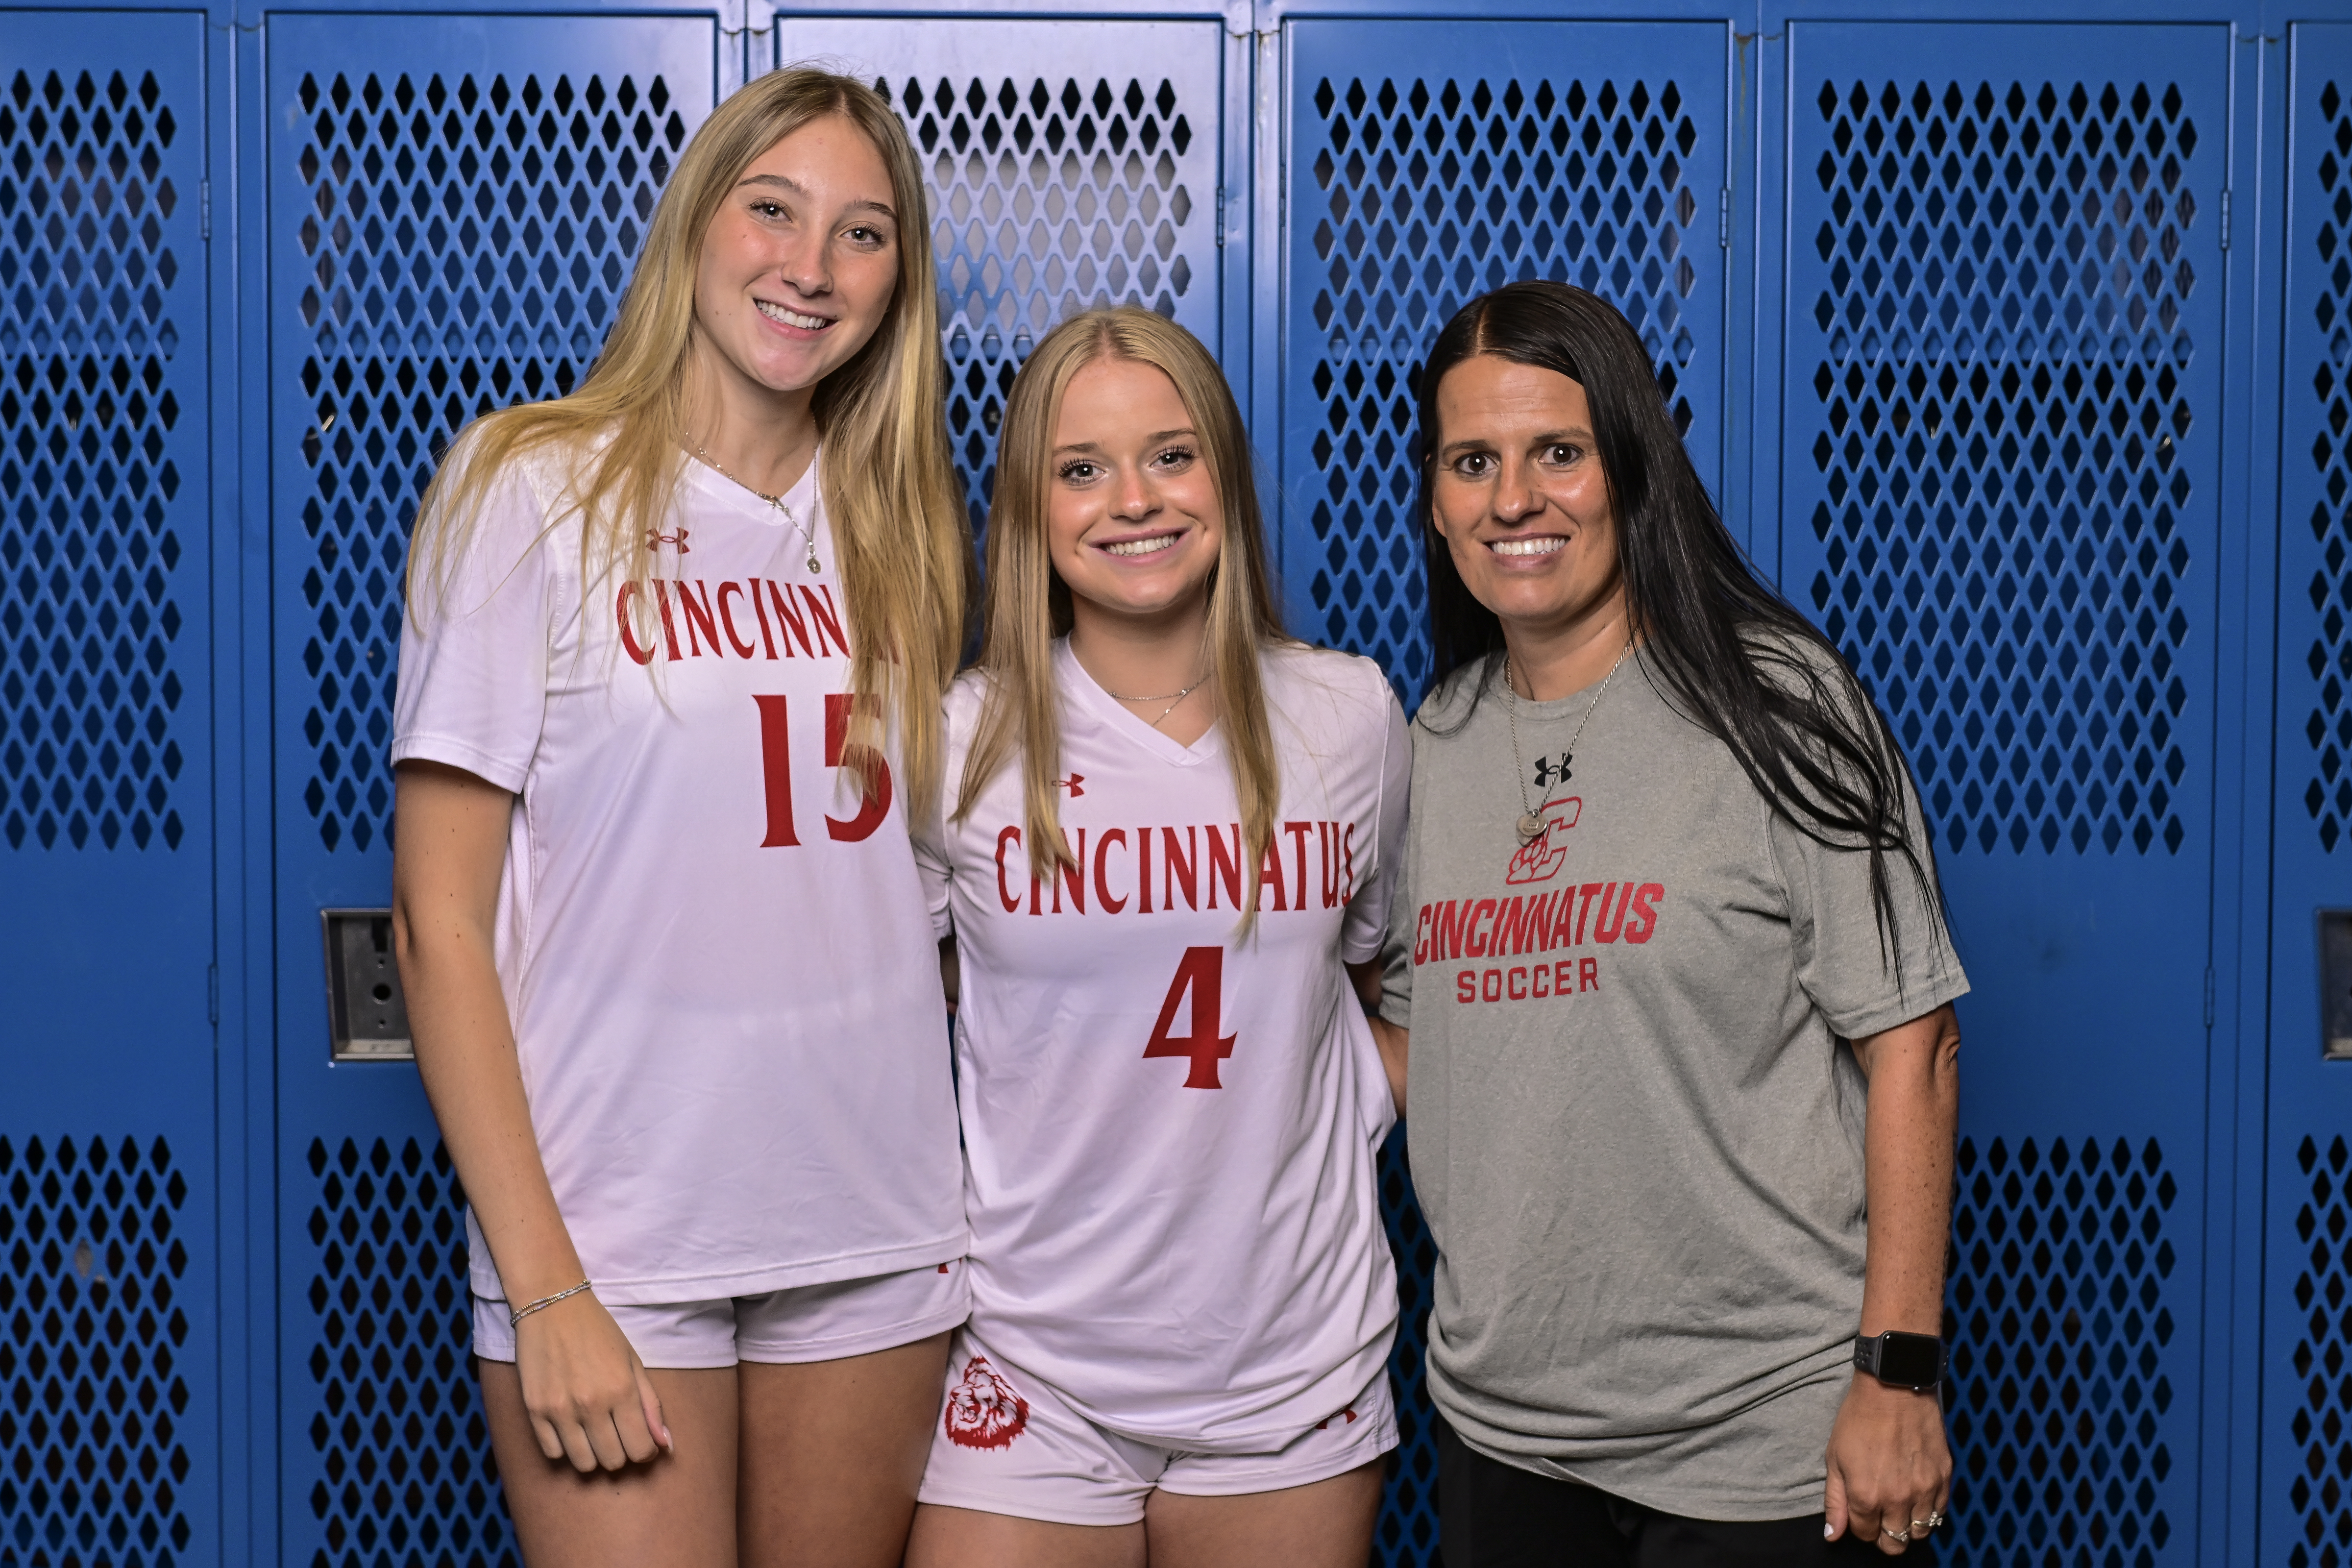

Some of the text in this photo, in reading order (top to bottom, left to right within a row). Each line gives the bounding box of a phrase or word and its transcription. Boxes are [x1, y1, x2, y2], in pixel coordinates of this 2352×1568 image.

[616, 578, 900, 665] CINCINN
[752, 693, 893, 848] 15
[1414, 882, 1665, 966] CINCINNATUS
[1142, 946, 1238, 1089] 4
[1457, 957, 1599, 1004] SOCCER
